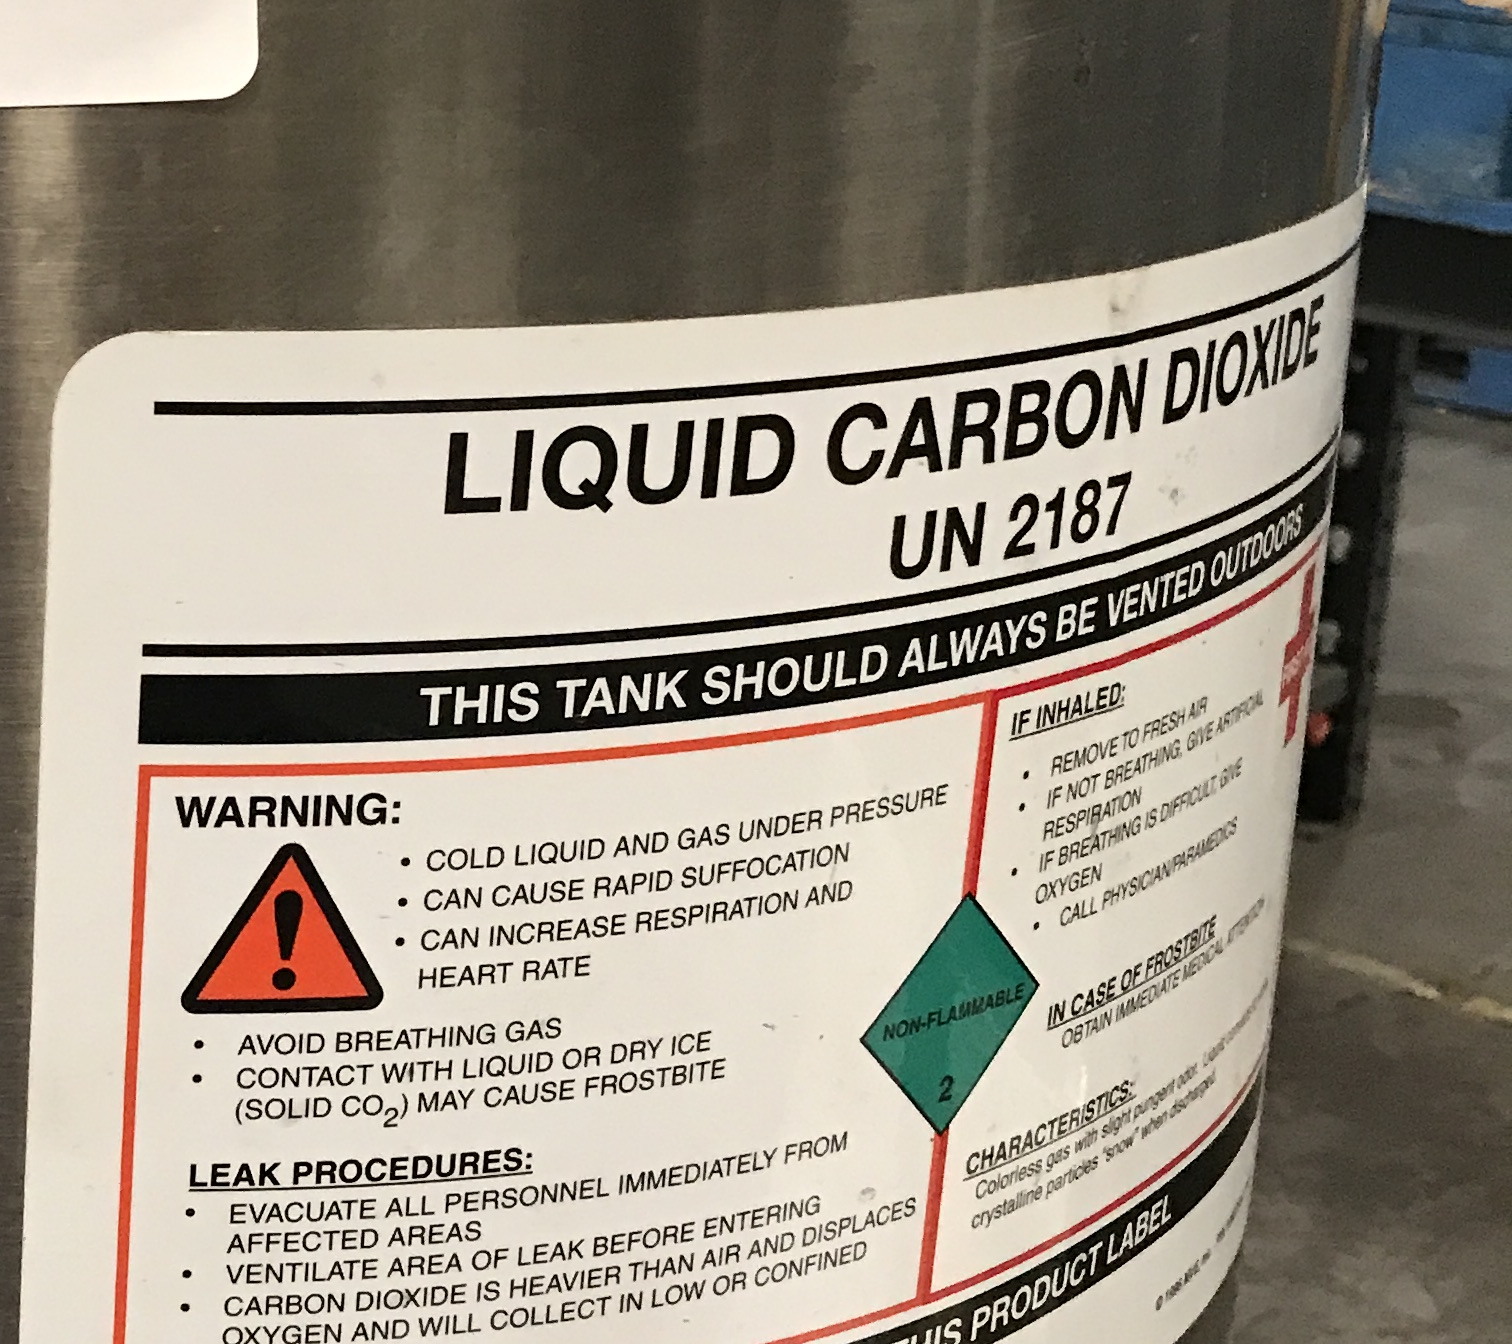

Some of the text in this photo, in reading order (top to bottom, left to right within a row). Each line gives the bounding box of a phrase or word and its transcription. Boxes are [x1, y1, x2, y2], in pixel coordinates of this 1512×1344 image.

[442, 294, 1327, 516] LIQUID CARBON DIOXIDE
[887, 471, 1135, 581] UN 2187
[419, 503, 1304, 727] THIS TANK SHOULD ALWAYS BE VENTED OUTDOORS
[1010, 681, 1127, 737] IF INHALED:
[1049, 735, 1119, 777] REMOVE
[1121, 726, 1140, 752] TO
[1142, 705, 1186, 744] FRESH
[174, 792, 402, 829] WARNING:
[425, 783, 950, 872] COLD LIQUID AND GAS UNDER PRESSURE
[1041, 785, 1143, 842] RESPIRATION
[422, 841, 851, 912] CAN CAUSE RAPID SUFFOCATION
[1034, 862, 1103, 905] OXYGEN
[1058, 892, 1098, 927] CALL
[419, 879, 855, 952] CAN INCREASE RESPIRATION AND
[417, 954, 592, 991] HEART RATE
[1046, 914, 1218, 1027] IN CASE OF FROSTBITE
[236, 1017, 562, 1057] AVOID BREATHING GAS
[881, 982, 1026, 1043] NON-FLAMMABLE
[234, 1096, 333, 1126] (SOLID
[416, 1088, 475, 1115] MAY
[482, 1078, 576, 1108] CAUSE
[583, 1057, 727, 1099] FROSTBITE
[235, 1031, 713, 1090] CONTACT WITH LIQUID OR DRY ICE
[936, 1075, 955, 1103] 2
[964, 1078, 1137, 1176] CHARACTERISTICS:
[188, 1146, 534, 1189] LEAK PROCEDURES:
[228, 1130, 849, 1225] EVACUATE ALL PERSONNEL IMMEDIATELY FROM
[222, 1196, 918, 1318] CARBON DIOXIDE IS HEAVIER THAN AIR AND DISPLACES
[225, 1220, 483, 1255] AFFECTED AREAS
[225, 1194, 822, 1285] VENTILATE AREA OF LEAK BEFORE ENTERING
[969, 1246, 1100, 1343] PRODUCT
[1105, 1194, 1173, 1260] LABEL
[350, 1318, 411, 1344] AND
[417, 1312, 481, 1338] WILL
[489, 1295, 613, 1332] COLLECT
[618, 1291, 644, 1315] IN
[650, 1278, 707, 1310] LOW
[712, 1270, 748, 1297] OR
[753, 1240, 868, 1288] CONFINED
